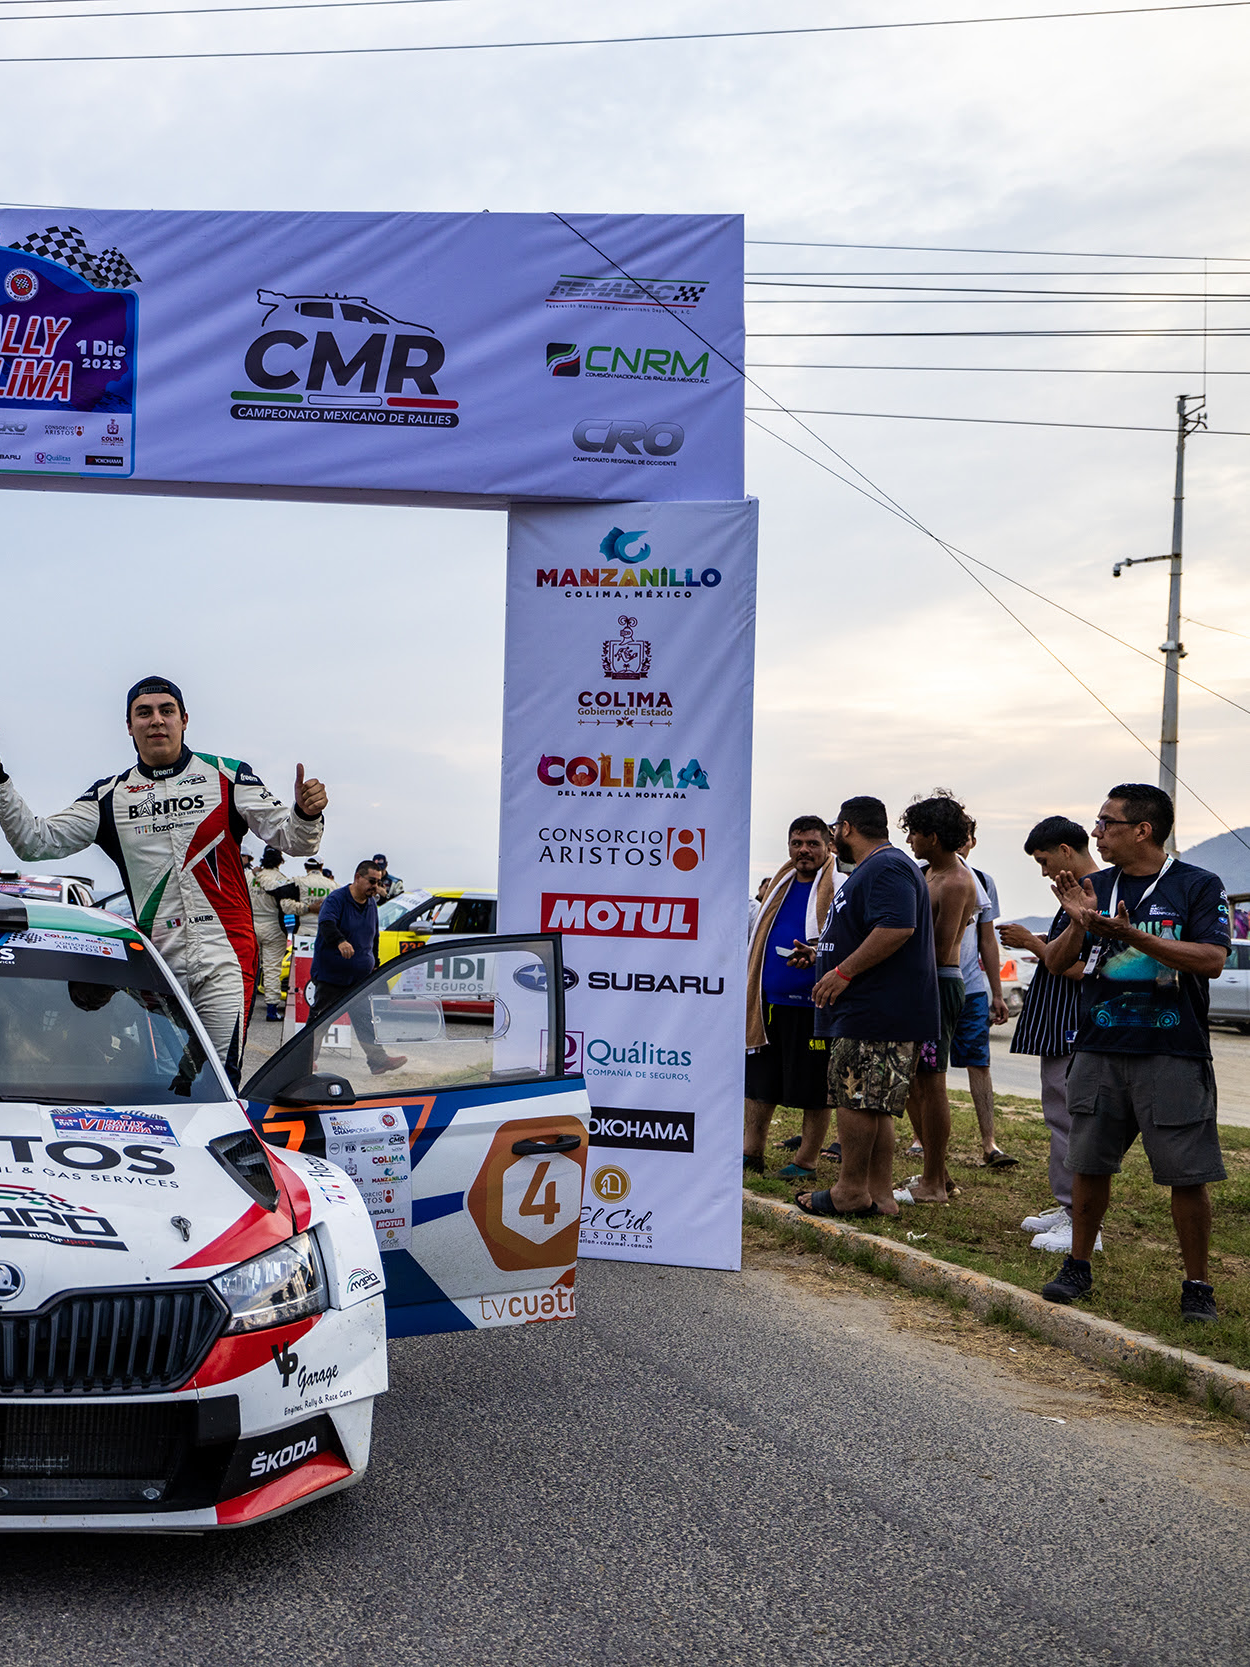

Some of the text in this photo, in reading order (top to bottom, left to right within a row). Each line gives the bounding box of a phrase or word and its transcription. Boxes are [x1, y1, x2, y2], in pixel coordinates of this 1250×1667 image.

[76, 339, 126, 357] 1 Dic
[81, 358, 122, 371] 2023
[245, 330, 446, 395] CMR
[585, 346, 709, 377] CNRM
[238, 407, 451, 425] CAMPEONATO MEXICANO DE RALLIES
[573, 419, 684, 456] CRO
[46, 454, 71, 462] Quálitas
[536, 567, 722, 588] MANZANILLO
[565, 589, 692, 599] COLIMA, MÉXICO
[578, 708, 673, 716] Gobierno del Estado
[537, 752, 710, 789] COLIMA
[539, 827, 663, 844] CONSORCIO
[539, 846, 662, 866] ARISTOS
[308, 888, 330, 897] HDI
[548, 899, 691, 934] MOTUL
[44, 933, 79, 941] COLIMA
[55, 944, 100, 953] ARISTOS
[427, 957, 485, 980] HDI
[426, 983, 483, 992] SEGUROS
[588, 971, 724, 995] SUBARU
[587, 1039, 692, 1067] Quálitas
[815, 1040, 826, 1050] NBA
[587, 1068, 632, 1078] COMPAÑÍA
[636, 1071, 647, 1079] DE
[79, 1118, 106, 1130] VI
[105, 1125, 151, 1134] COLIMA
[389, 1136, 405, 1144] CMR
[372, 1155, 406, 1164] COLIMA
[22, 1167, 34, 1175] &
[43, 1168, 81, 1181] GAS
[90, 1174, 180, 1189] SERVICES
[372, 1175, 408, 1184] MANZANILLO
[518, 1161, 561, 1225] 4
[377, 1219, 404, 1228] MOTUL
[580, 1206, 653, 1232] El Cid
[29, 1231, 97, 1247] motorsport
[600, 1239, 626, 1247] cozumel
[298, 1364, 339, 1397] Garage
[284, 1405, 303, 1416] Engines,
[305, 1400, 318, 1409] Rally
[325, 1393, 338, 1402] Race
[340, 1389, 352, 1398] Cars
[250, 1435, 317, 1477] ŠKODA
